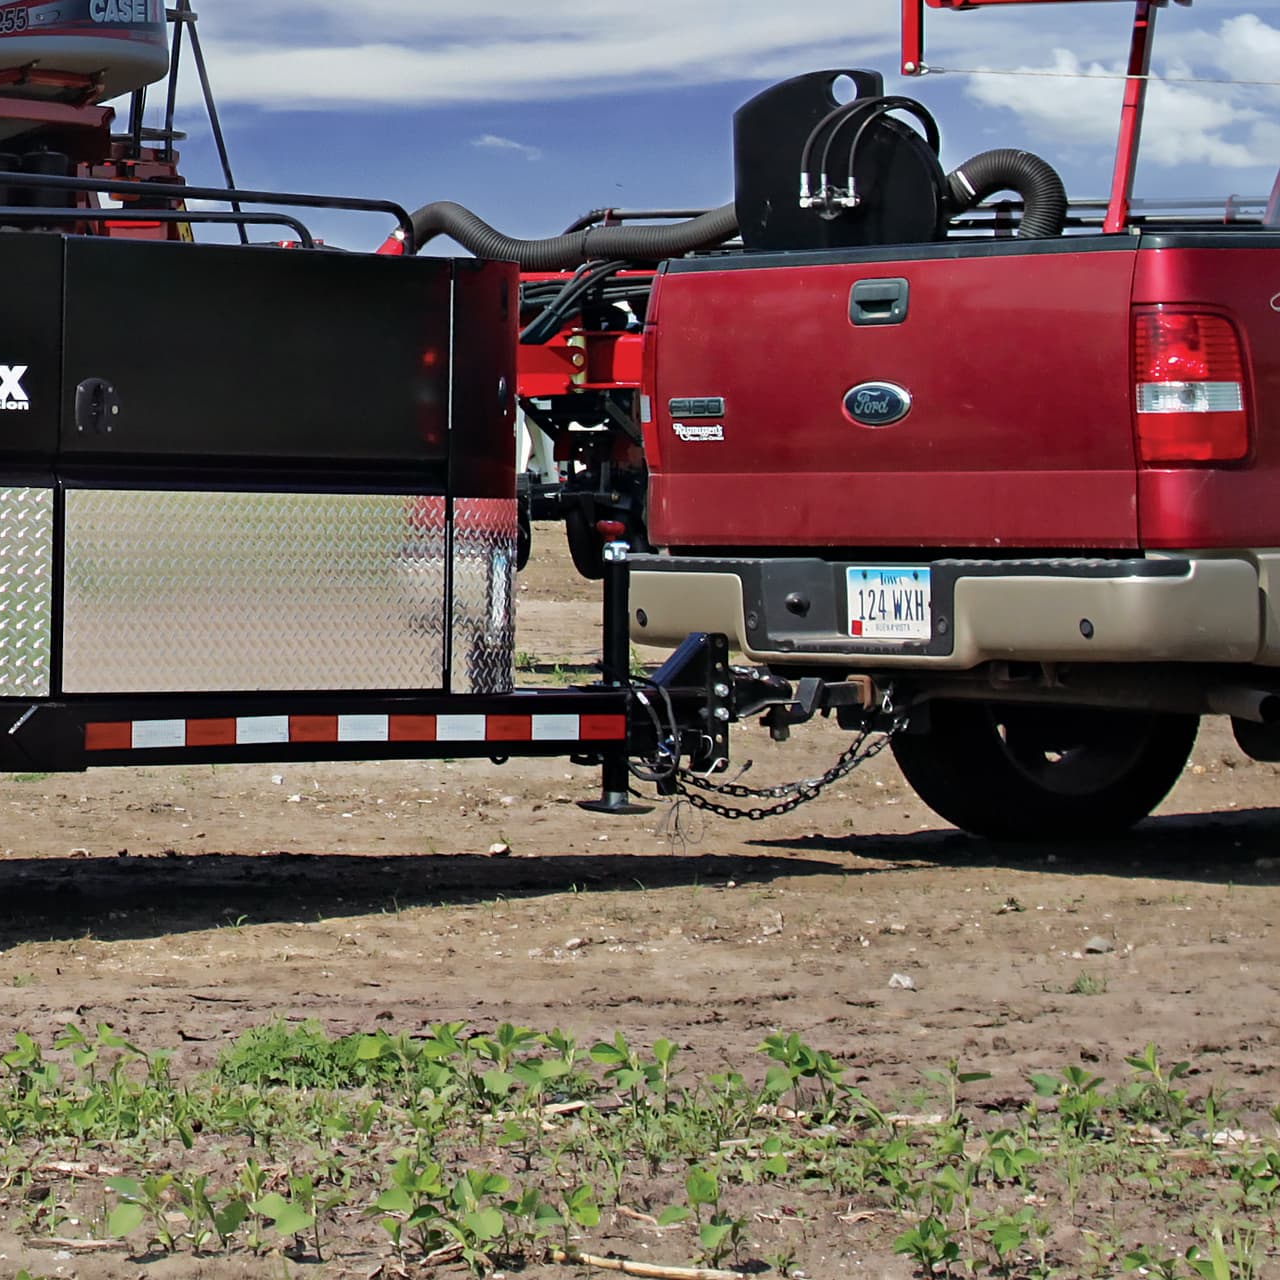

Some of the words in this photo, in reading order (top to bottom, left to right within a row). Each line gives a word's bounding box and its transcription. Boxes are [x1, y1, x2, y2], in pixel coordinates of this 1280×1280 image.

[854, 390, 890, 414] Ford
[859, 589, 886, 621] 124
[892, 589, 924, 621] WXH
